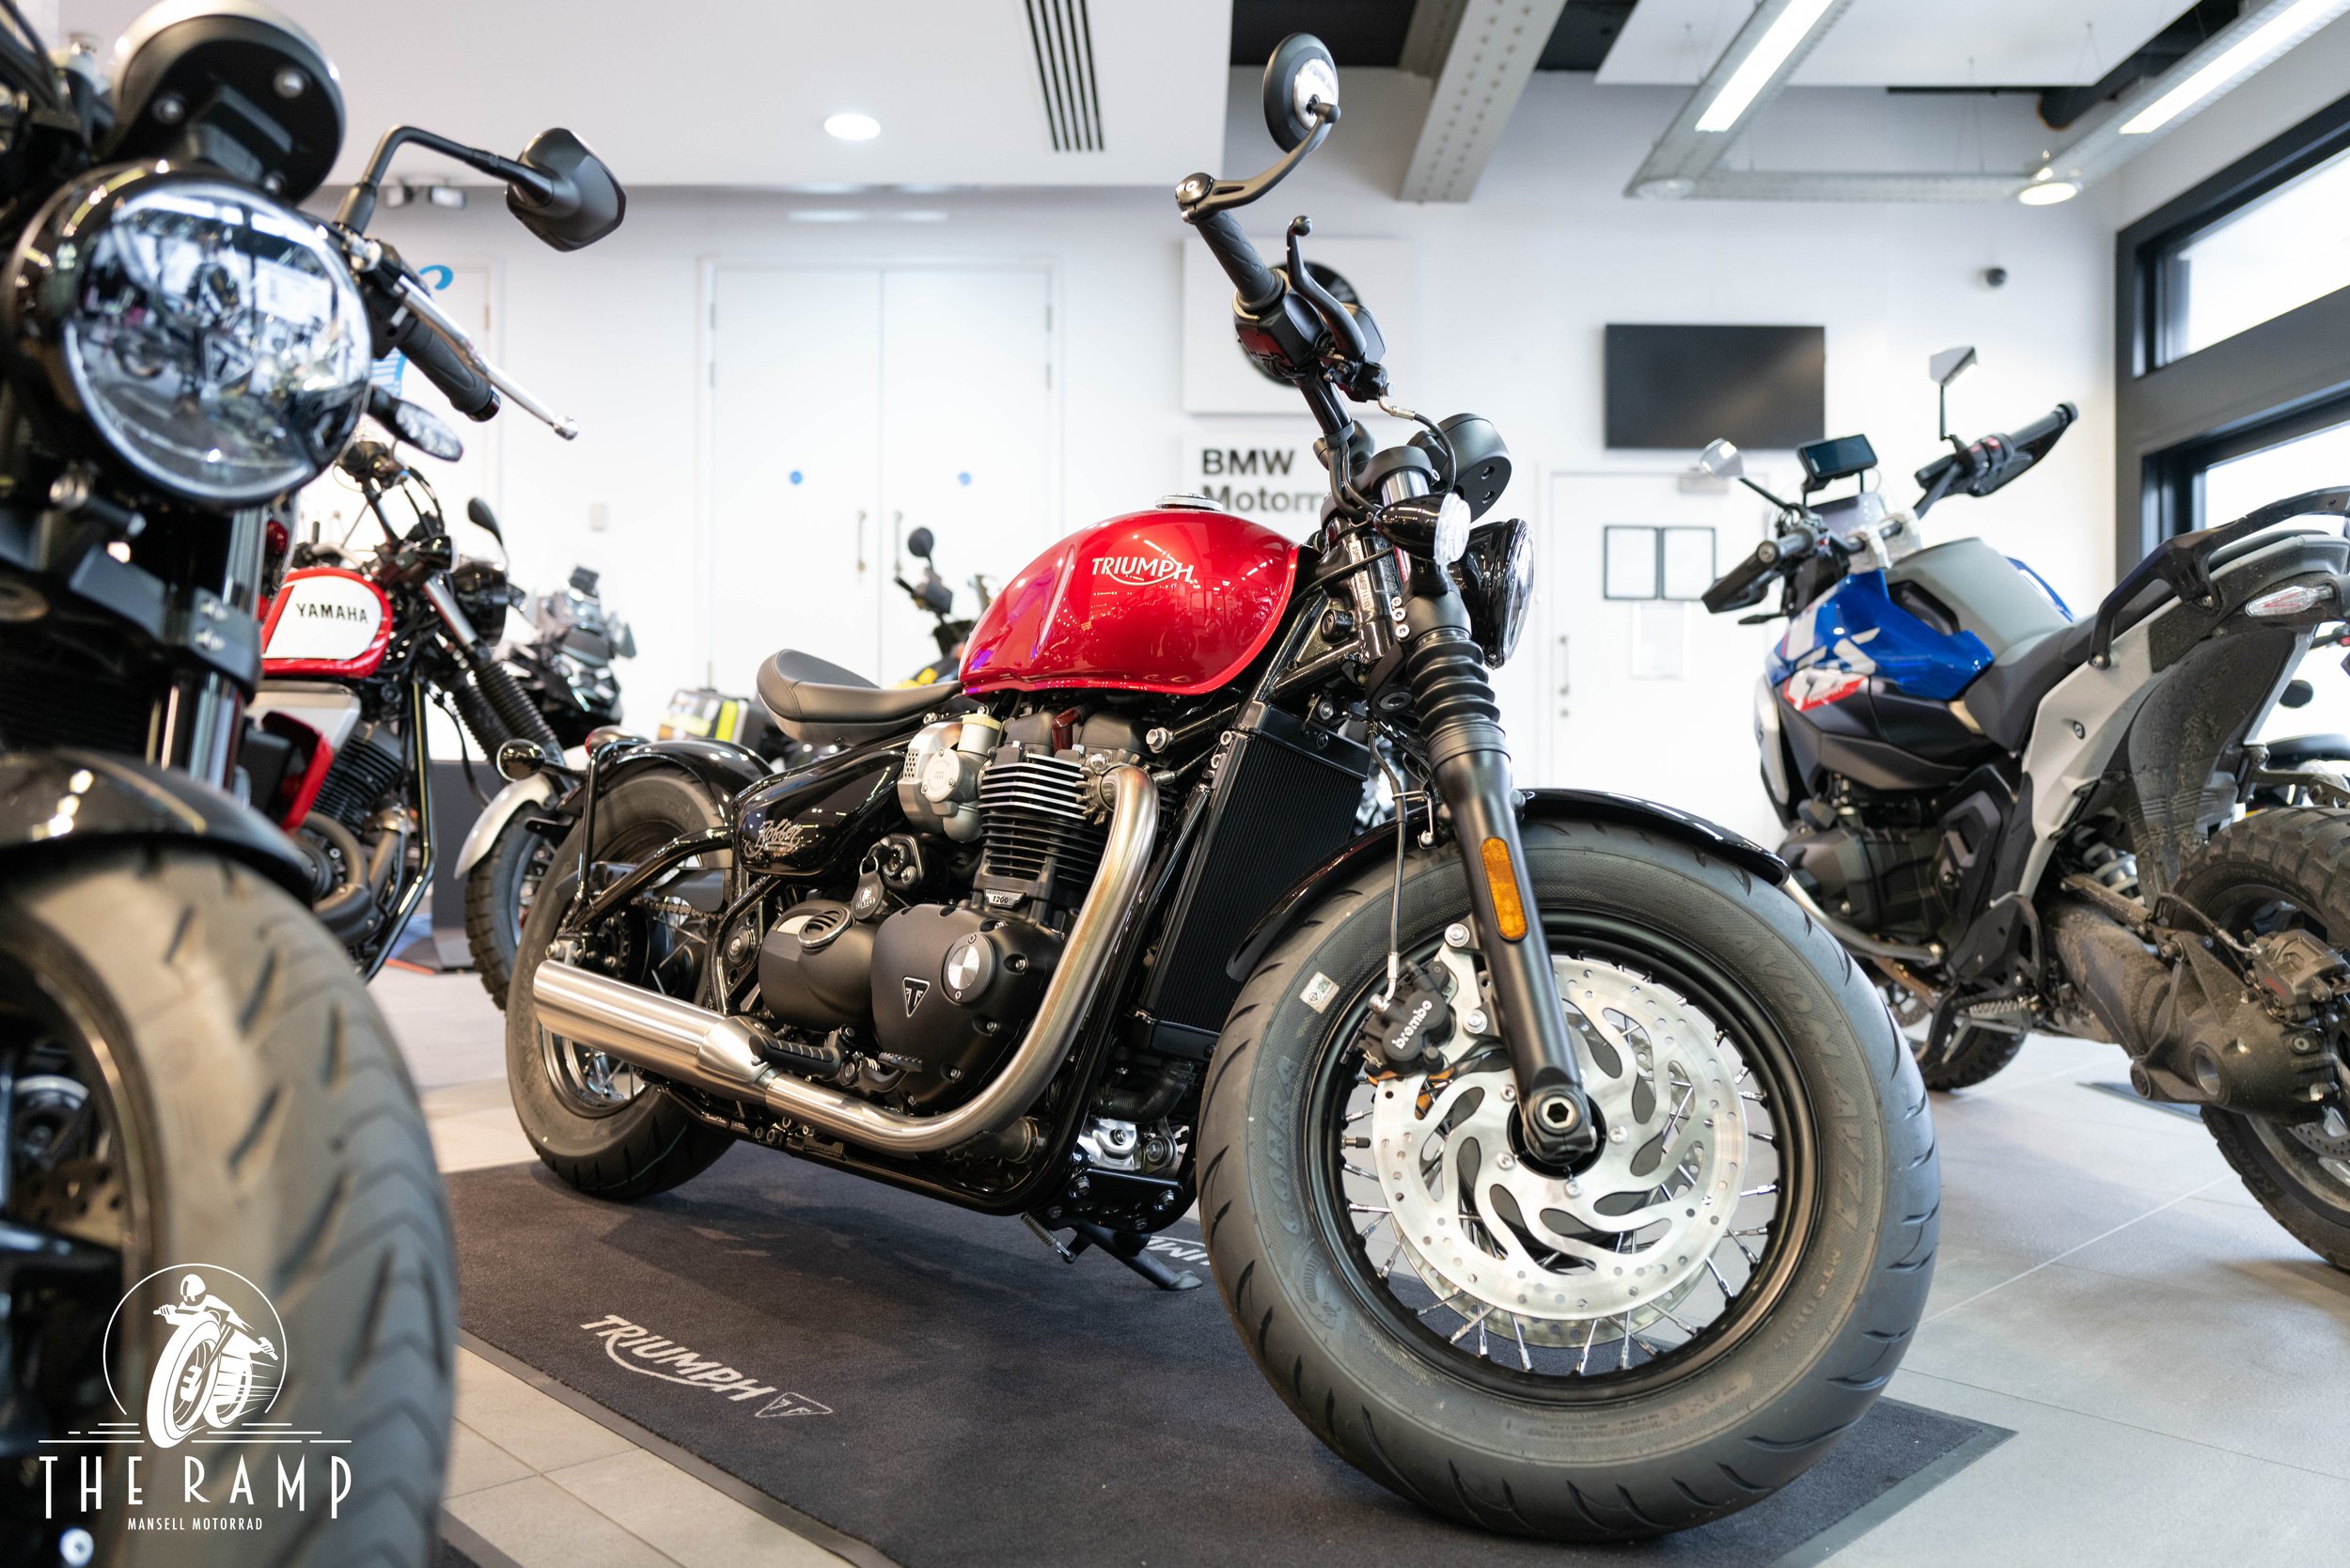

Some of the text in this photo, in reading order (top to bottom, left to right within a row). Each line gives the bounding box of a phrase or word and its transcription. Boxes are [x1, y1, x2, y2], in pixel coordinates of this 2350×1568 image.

[1203, 449, 1294, 475] BMW
[1091, 557, 1195, 586] TRIUMPH
[296, 603, 368, 623] YAMAHA
[1391, 1000, 1433, 1050] brembo
[1266, 1055, 1301, 1234] COBRA
[580, 1314, 778, 1402] TRIUMPH
